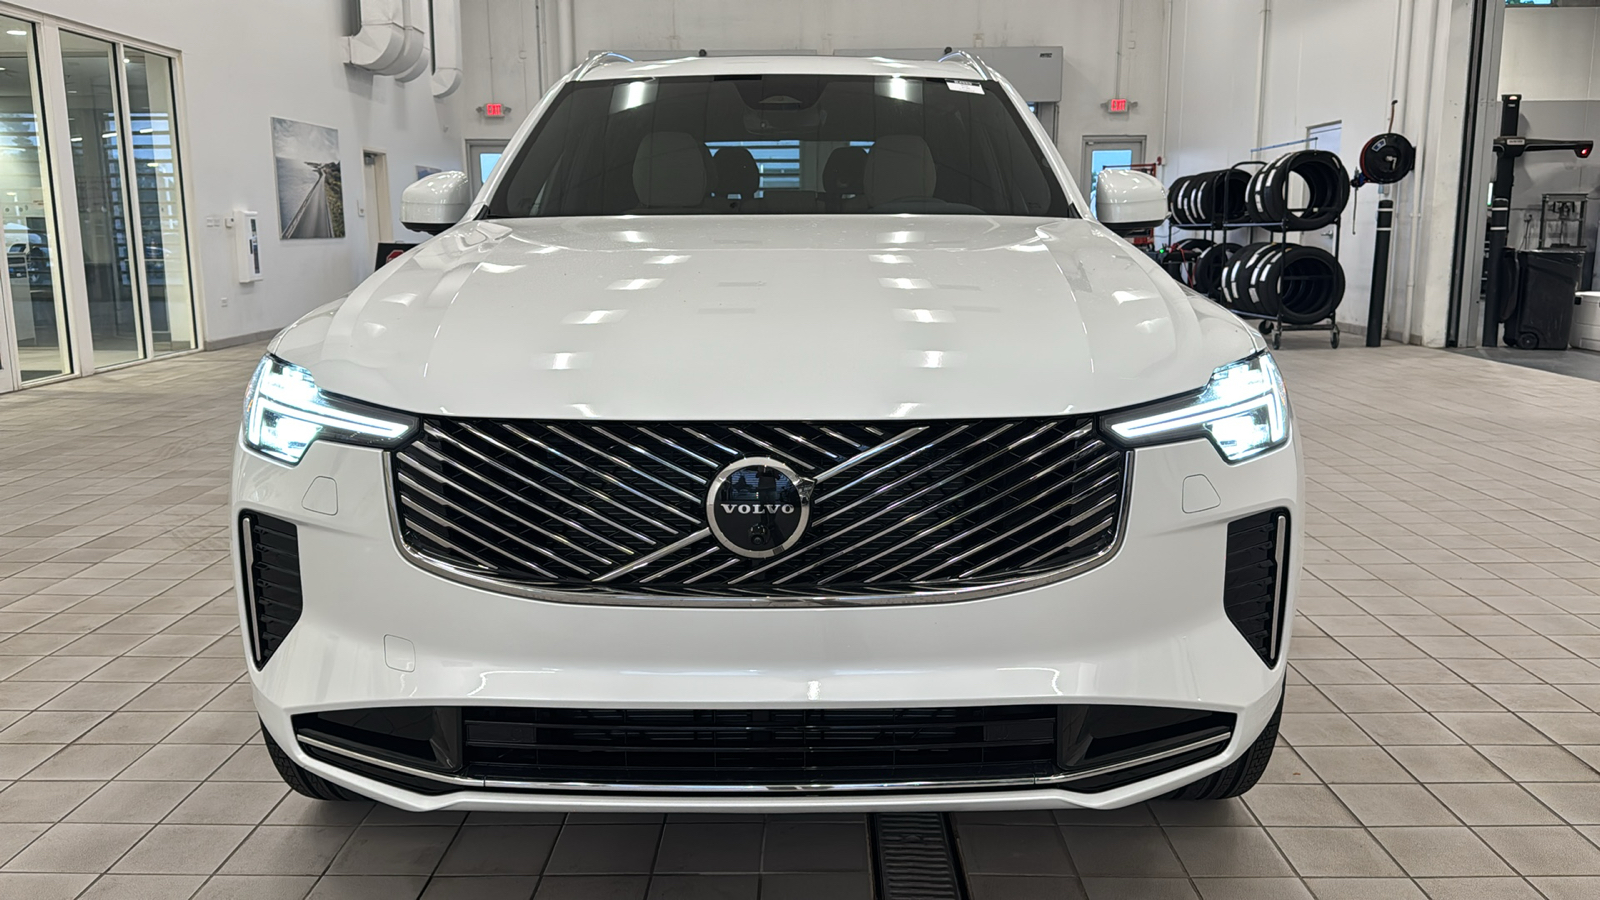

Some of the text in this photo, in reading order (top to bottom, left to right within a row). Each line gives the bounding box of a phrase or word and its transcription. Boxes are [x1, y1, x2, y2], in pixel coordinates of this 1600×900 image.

[487, 103, 502, 116] EXIT
[1111, 98, 1126, 111] EXIT
[721, 503, 795, 514] VOLVO
